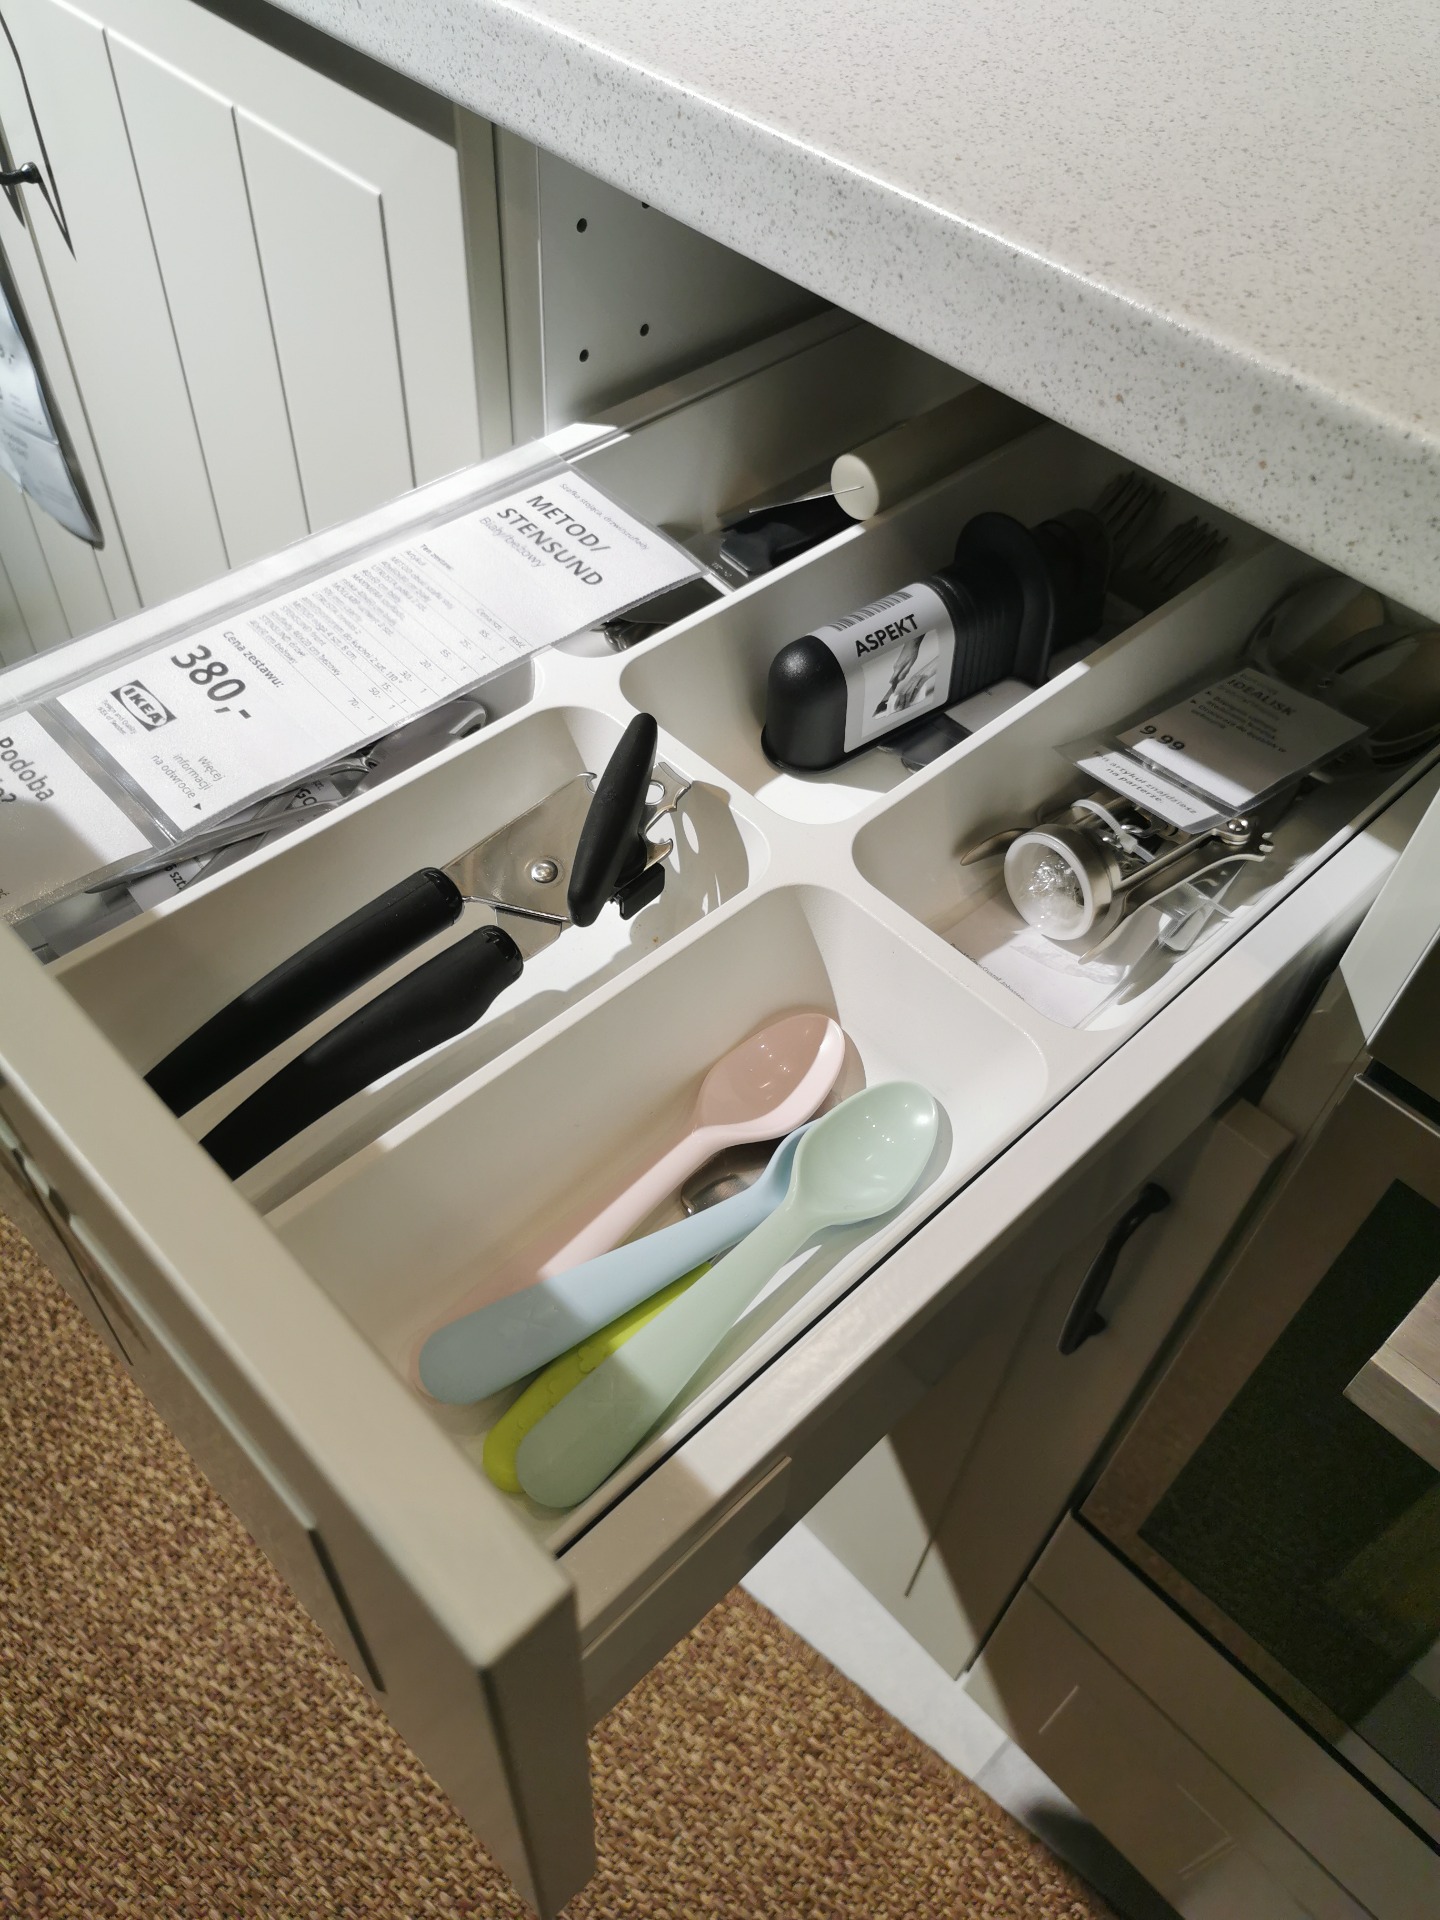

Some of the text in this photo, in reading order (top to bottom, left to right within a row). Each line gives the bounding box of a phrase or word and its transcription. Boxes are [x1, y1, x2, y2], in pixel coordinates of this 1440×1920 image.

[495, 504, 607, 590] STENSUND
[524, 493, 613, 557] METOD/
[220, 629, 287, 689] Cena zestawu:
[855, 613, 918, 658] ASPEKT
[122, 685, 166, 725] IKEA
[169, 643, 253, 721] 380,-
[1224, 678, 1298, 716] IDEALISK
[0, 736, 54, 802] Podoba
[148, 753, 199, 801] na odwrocie
[168, 751, 214, 793] informacji
[192, 754, 226, 784] Więcej
